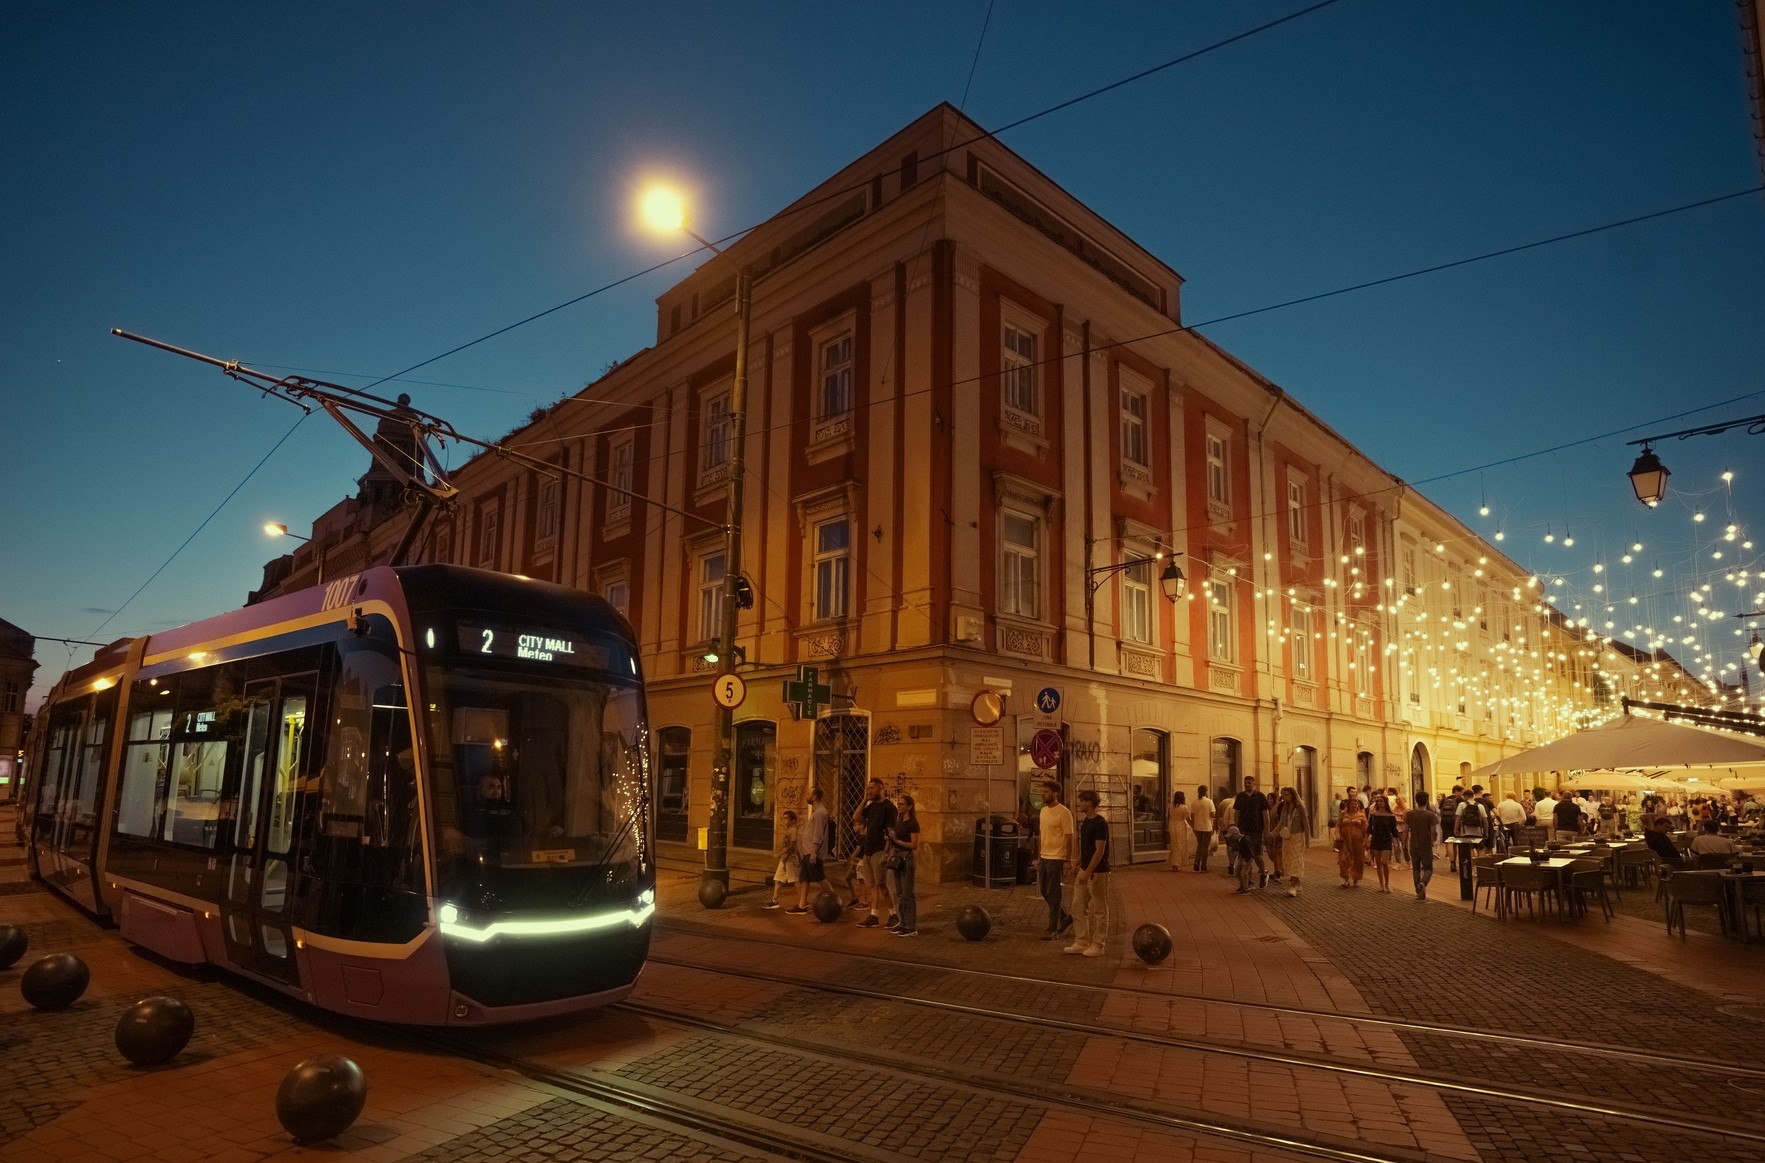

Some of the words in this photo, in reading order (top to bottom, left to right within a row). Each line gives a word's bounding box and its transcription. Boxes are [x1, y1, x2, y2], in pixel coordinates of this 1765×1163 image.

[321, 574, 359, 611] 1007
[481, 629, 494, 654] 2
[518, 634, 543, 649] CITY
[545, 638, 575, 654] MALL
[726, 681, 734, 700] 5
